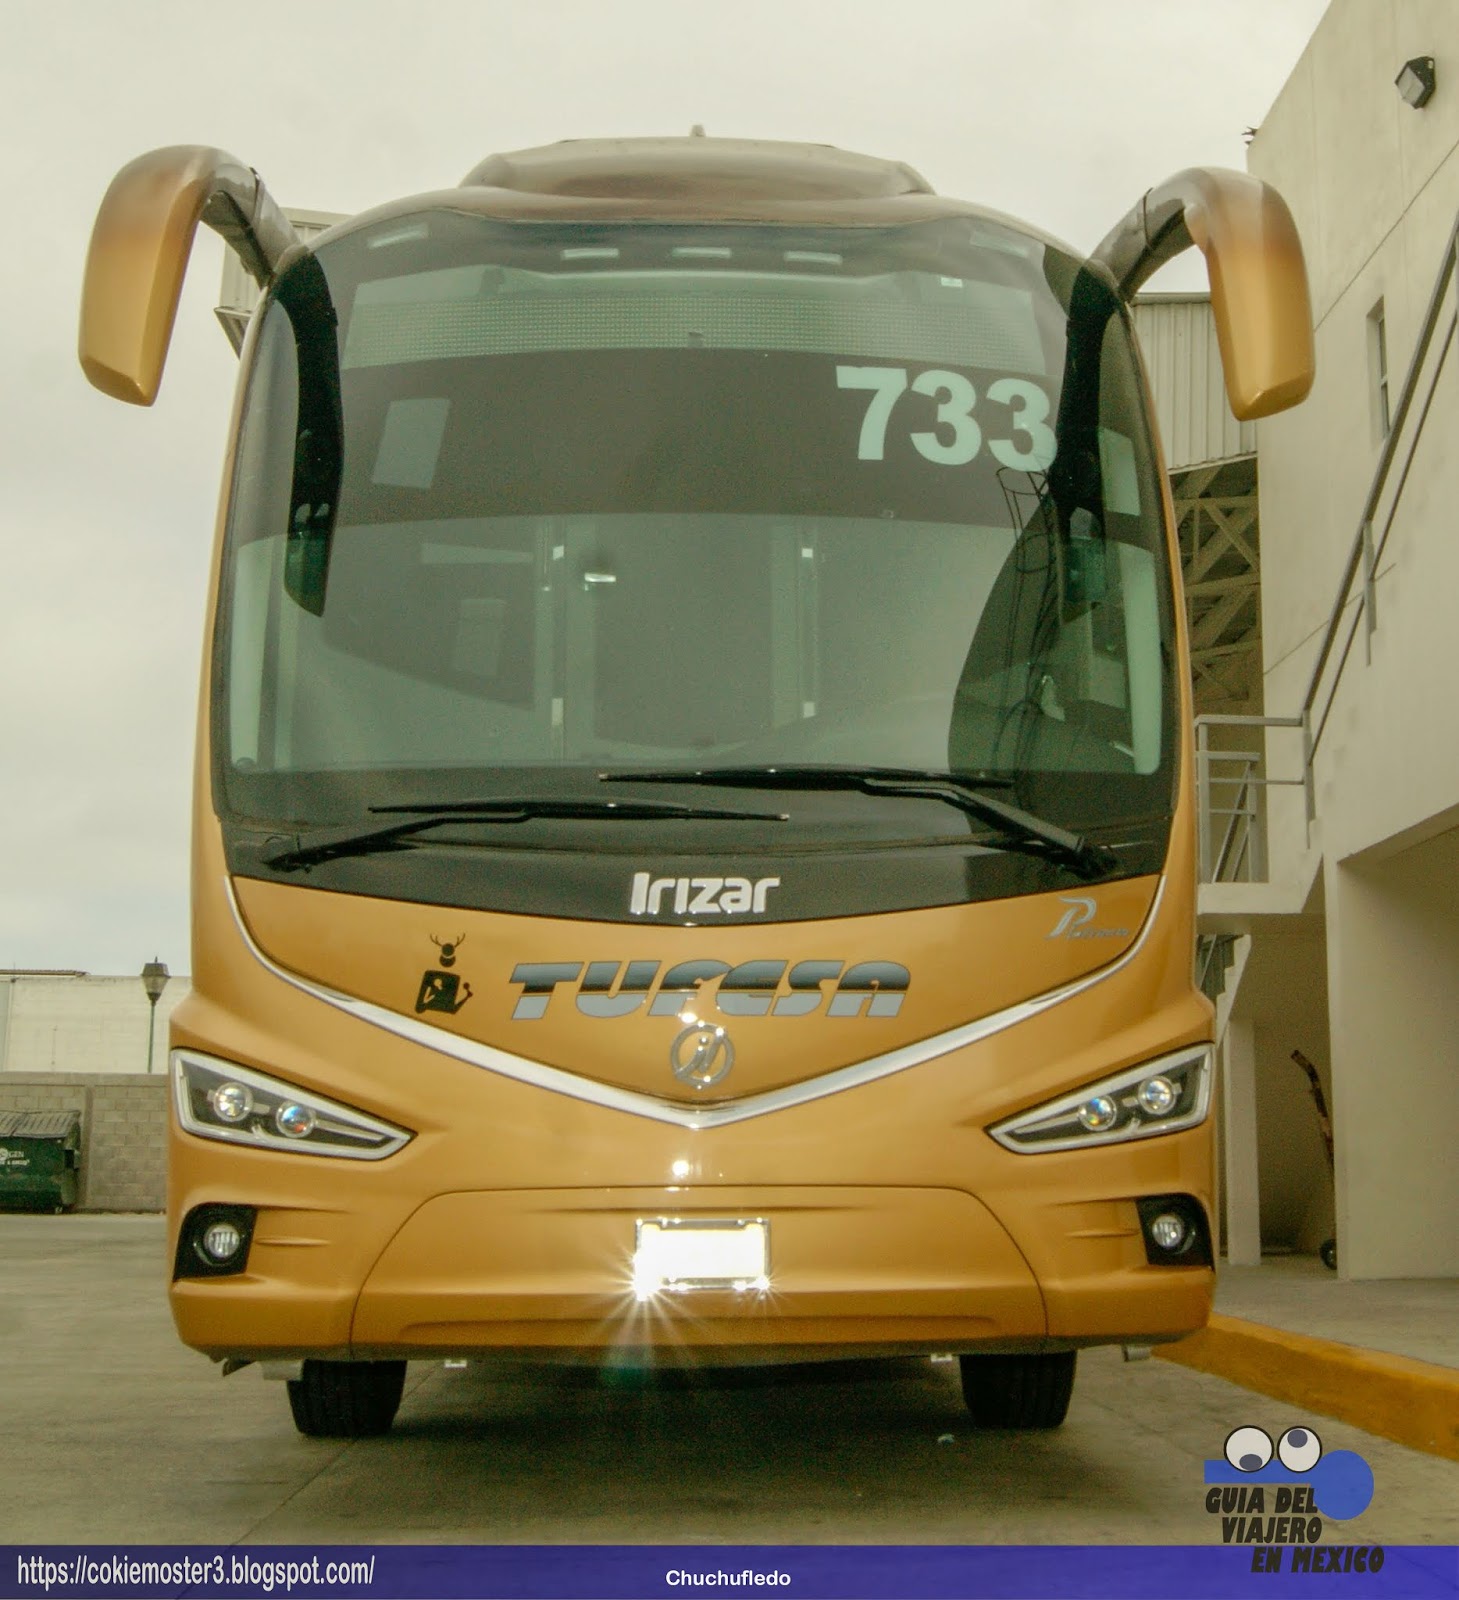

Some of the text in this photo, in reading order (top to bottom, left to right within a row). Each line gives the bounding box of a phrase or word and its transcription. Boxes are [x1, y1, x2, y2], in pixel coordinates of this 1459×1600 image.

[836, 365, 1058, 472] 733
[630, 872, 780, 914] Irizar
[509, 960, 911, 1020] TUFESA
